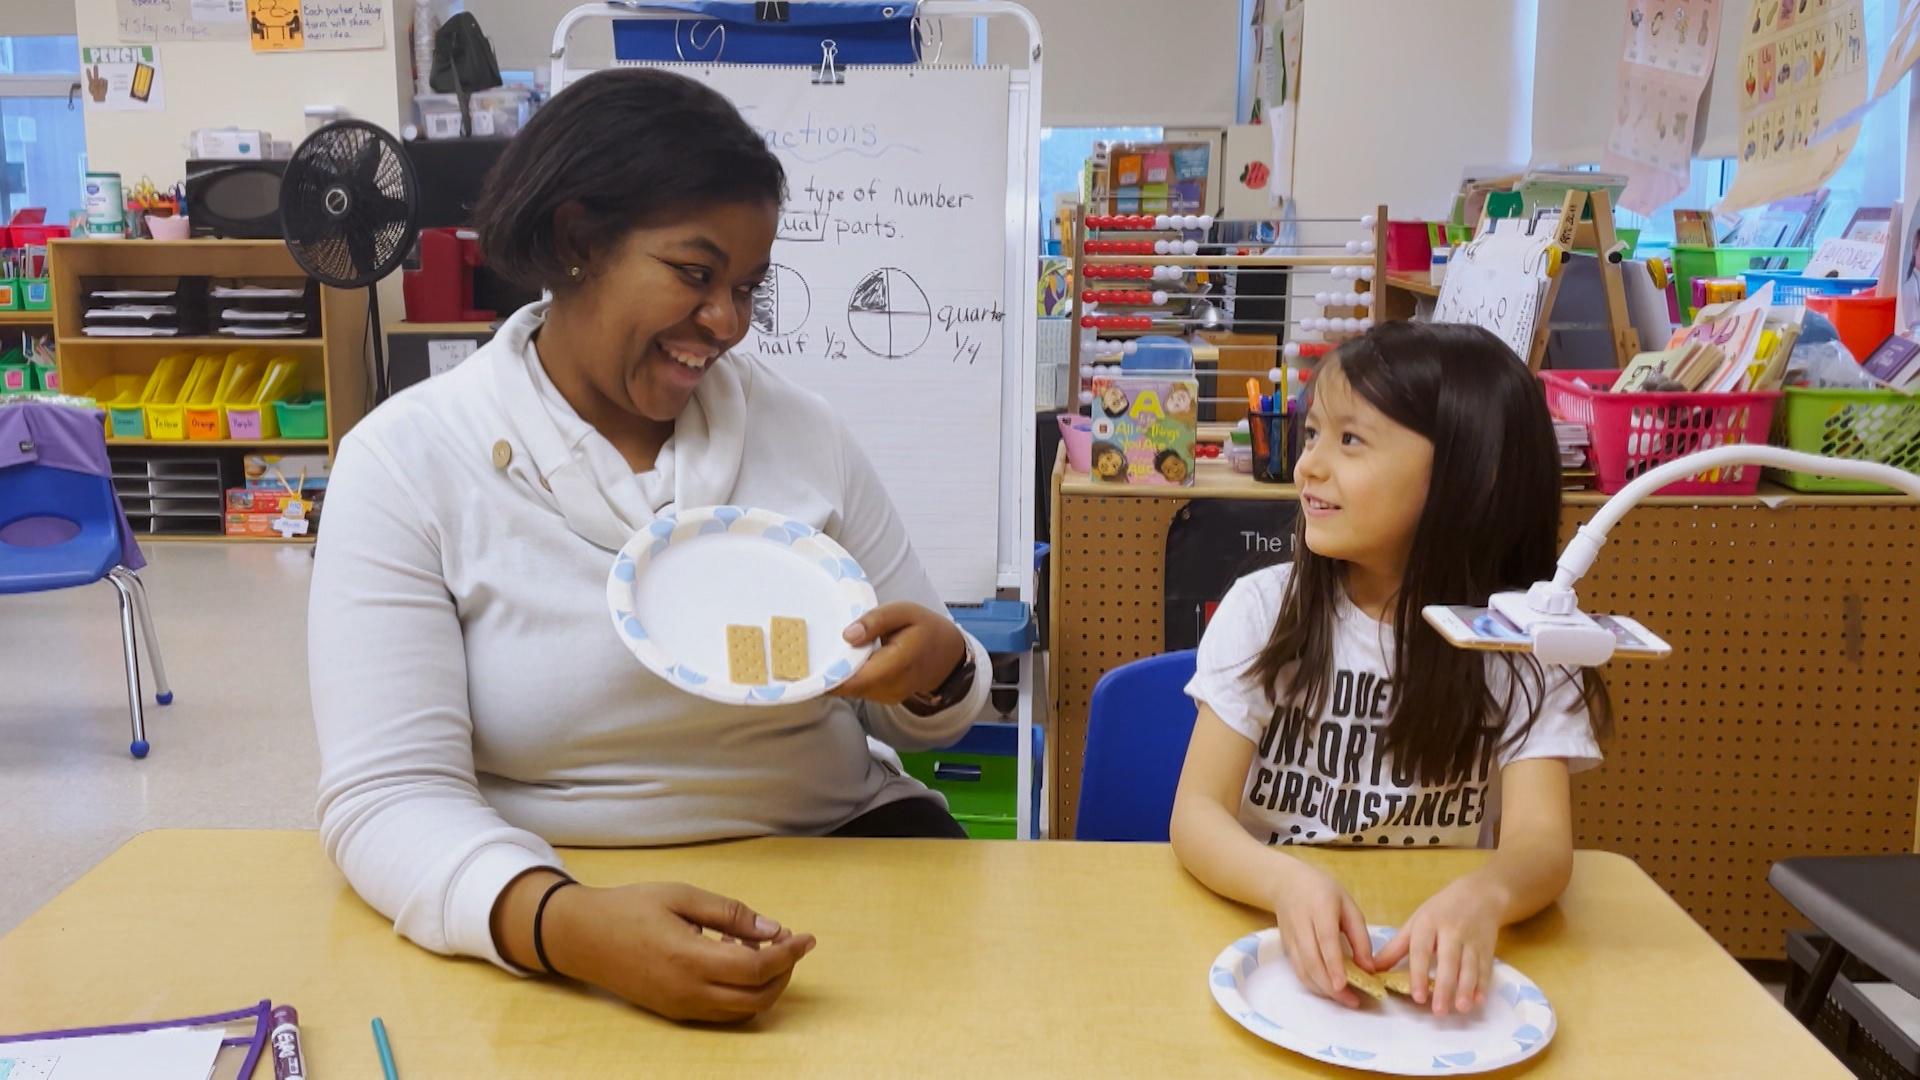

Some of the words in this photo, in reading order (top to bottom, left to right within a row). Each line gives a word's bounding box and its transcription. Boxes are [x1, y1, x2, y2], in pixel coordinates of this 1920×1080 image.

[90, 47, 147, 64] PENCIL
[805, 176, 845, 215] type
[853, 178, 880, 201] of
[894, 183, 974, 209] number
[783, 208, 819, 232] ual
[834, 213, 904, 245] parts.
[757, 333, 809, 355] half
[1129, 389, 1165, 420] A
[191, 418, 216, 431] Orange
[1240, 531, 1282, 552] The
[1332, 669, 1392, 719] DUE
[1250, 767, 1488, 834] CIRCUMSTANCES
